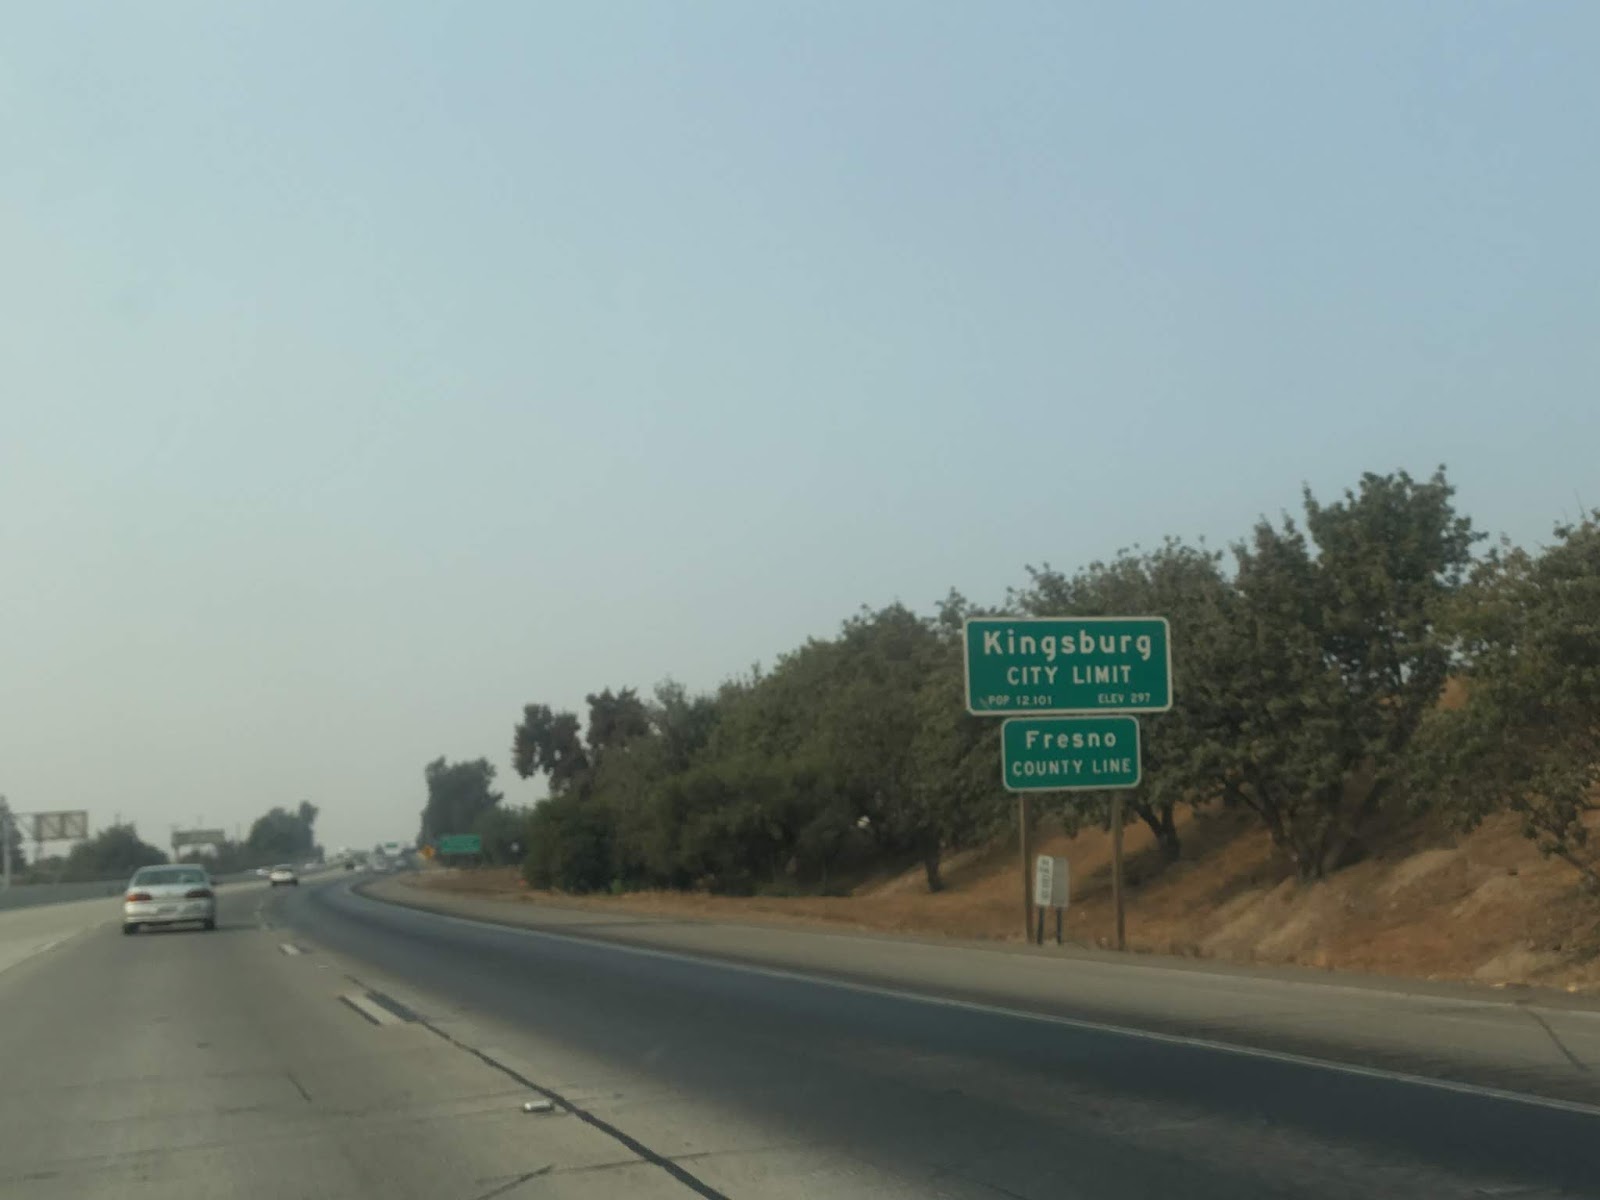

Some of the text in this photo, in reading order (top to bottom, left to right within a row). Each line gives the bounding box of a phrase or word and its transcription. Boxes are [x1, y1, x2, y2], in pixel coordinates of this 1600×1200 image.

[983, 629, 1151, 661] Kingsburg
[1007, 665, 1131, 685] CITY LIMIT
[988, 695, 1010, 706] POP
[1098, 692, 1151, 704] ELEV 297
[1026, 730, 1116, 749] Fresno
[1012, 758, 1132, 776] COUNTY LINE
